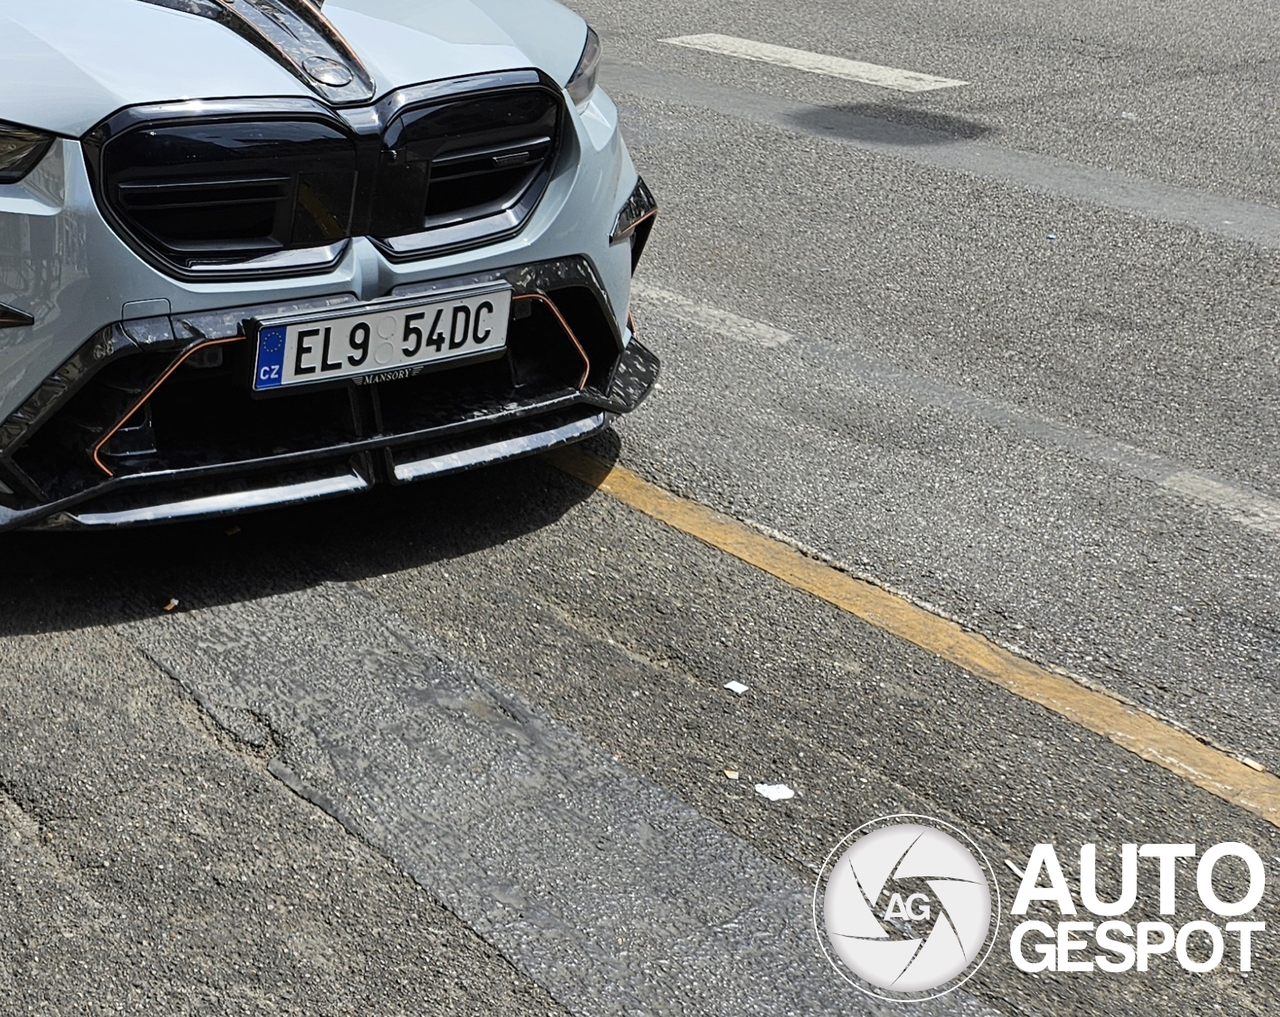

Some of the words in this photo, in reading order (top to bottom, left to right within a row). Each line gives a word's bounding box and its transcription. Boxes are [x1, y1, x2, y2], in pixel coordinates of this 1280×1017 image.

[260, 365, 279, 380] CZ
[294, 321, 371, 376] EL9
[402, 300, 494, 358] 54DC
[363, 367, 412, 386] MANSORY
